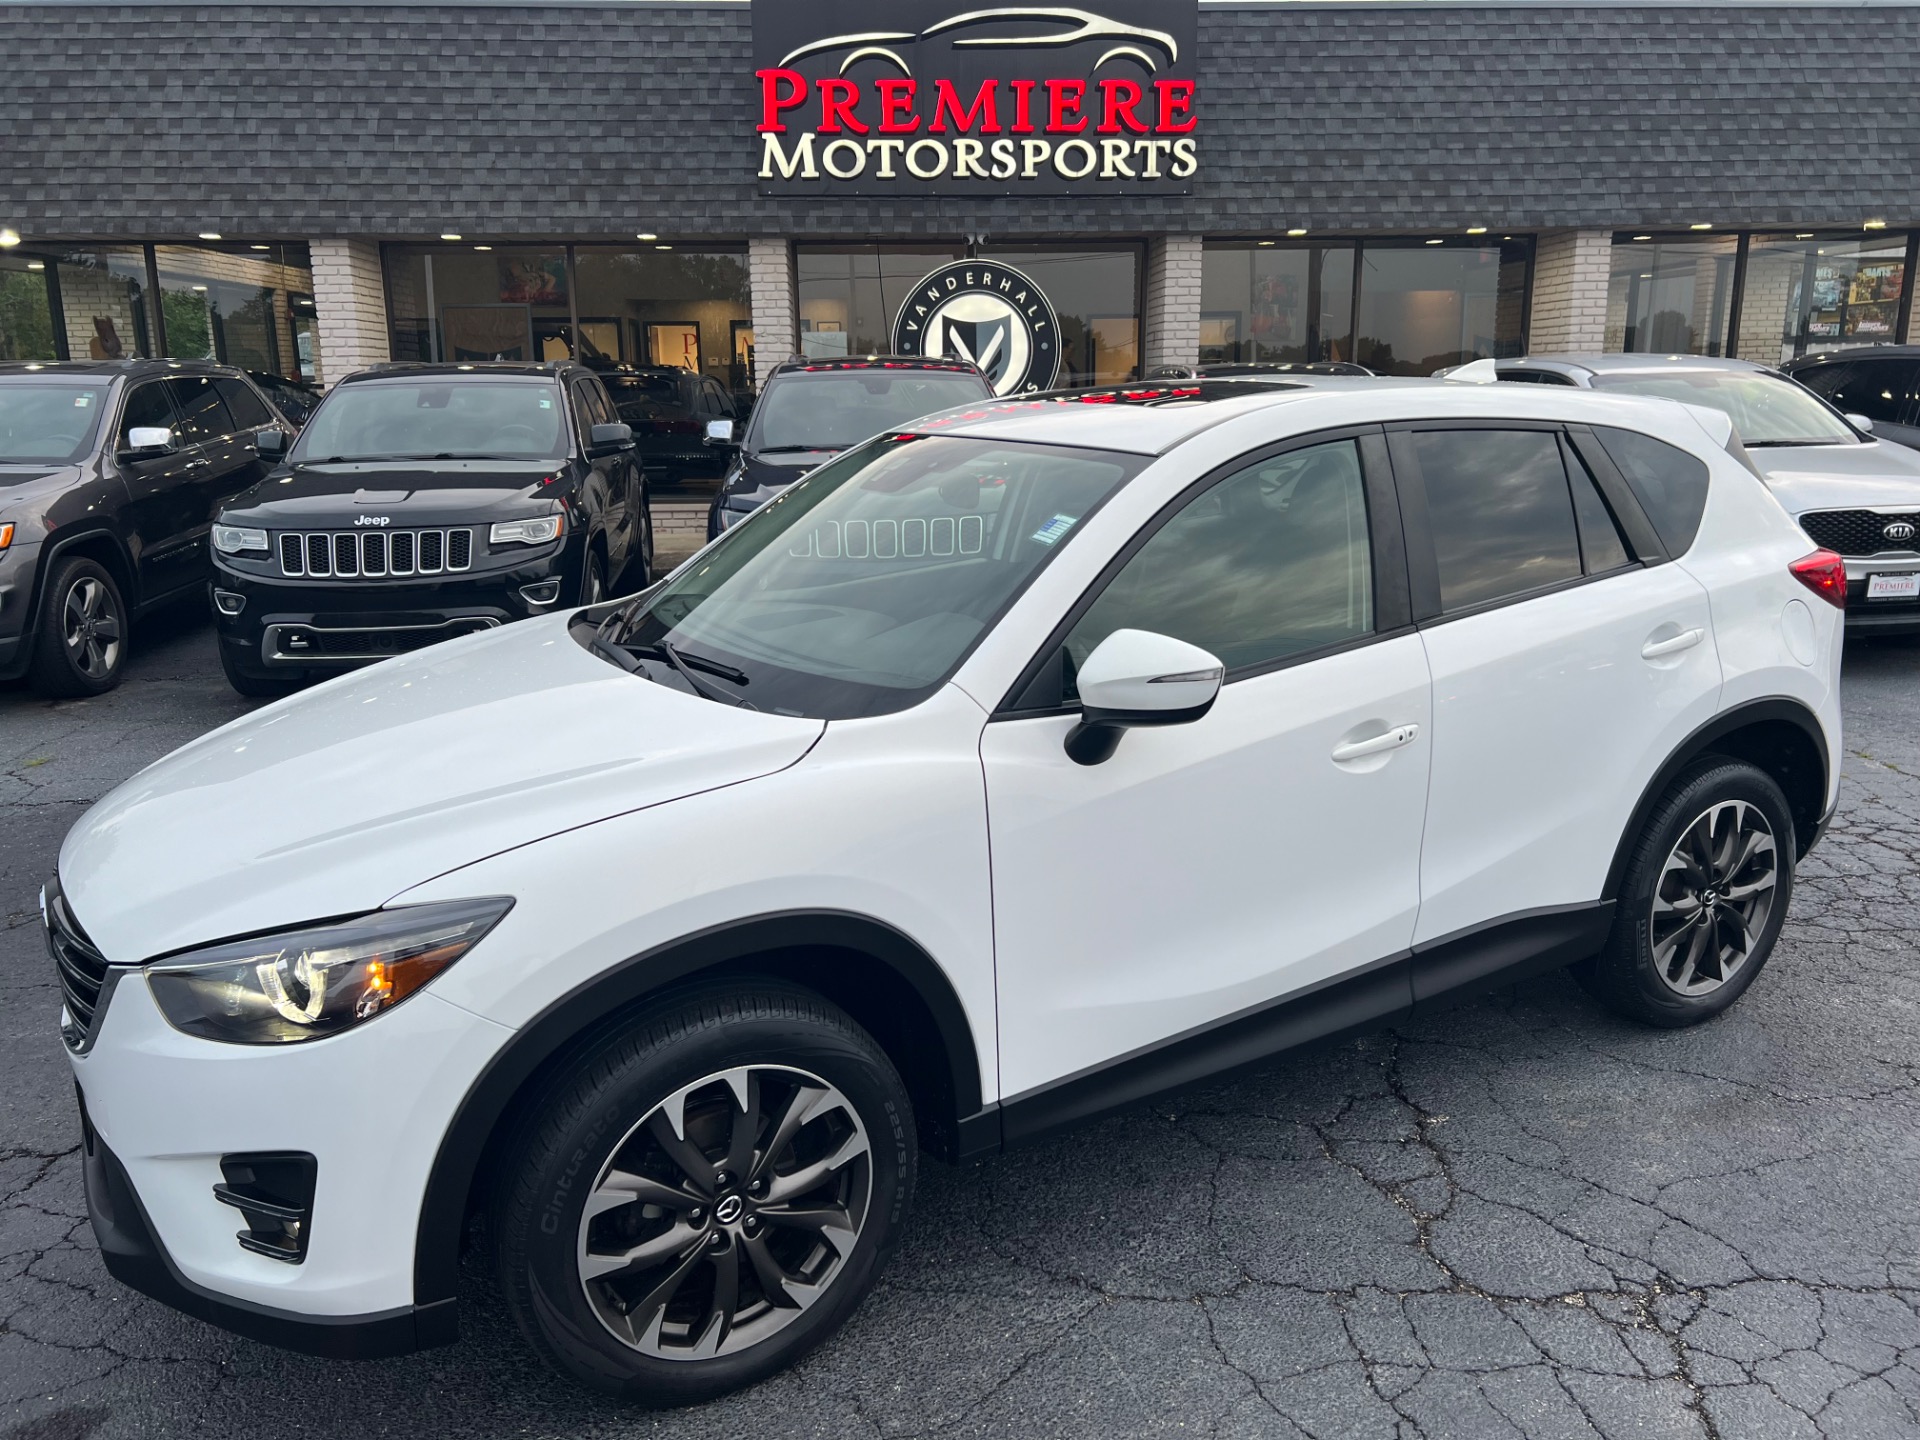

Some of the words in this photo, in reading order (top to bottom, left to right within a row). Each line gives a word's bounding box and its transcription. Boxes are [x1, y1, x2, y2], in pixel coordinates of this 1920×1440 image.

[755, 68, 1198, 133] PREMIERE
[757, 132, 1198, 179] MOTORSPORTS
[906, 272, 1046, 332] VANDERHALL
[353, 514, 391, 527] Jeep
[1889, 526, 1911, 538] KIA
[884, 1100, 907, 1179] 225/55
